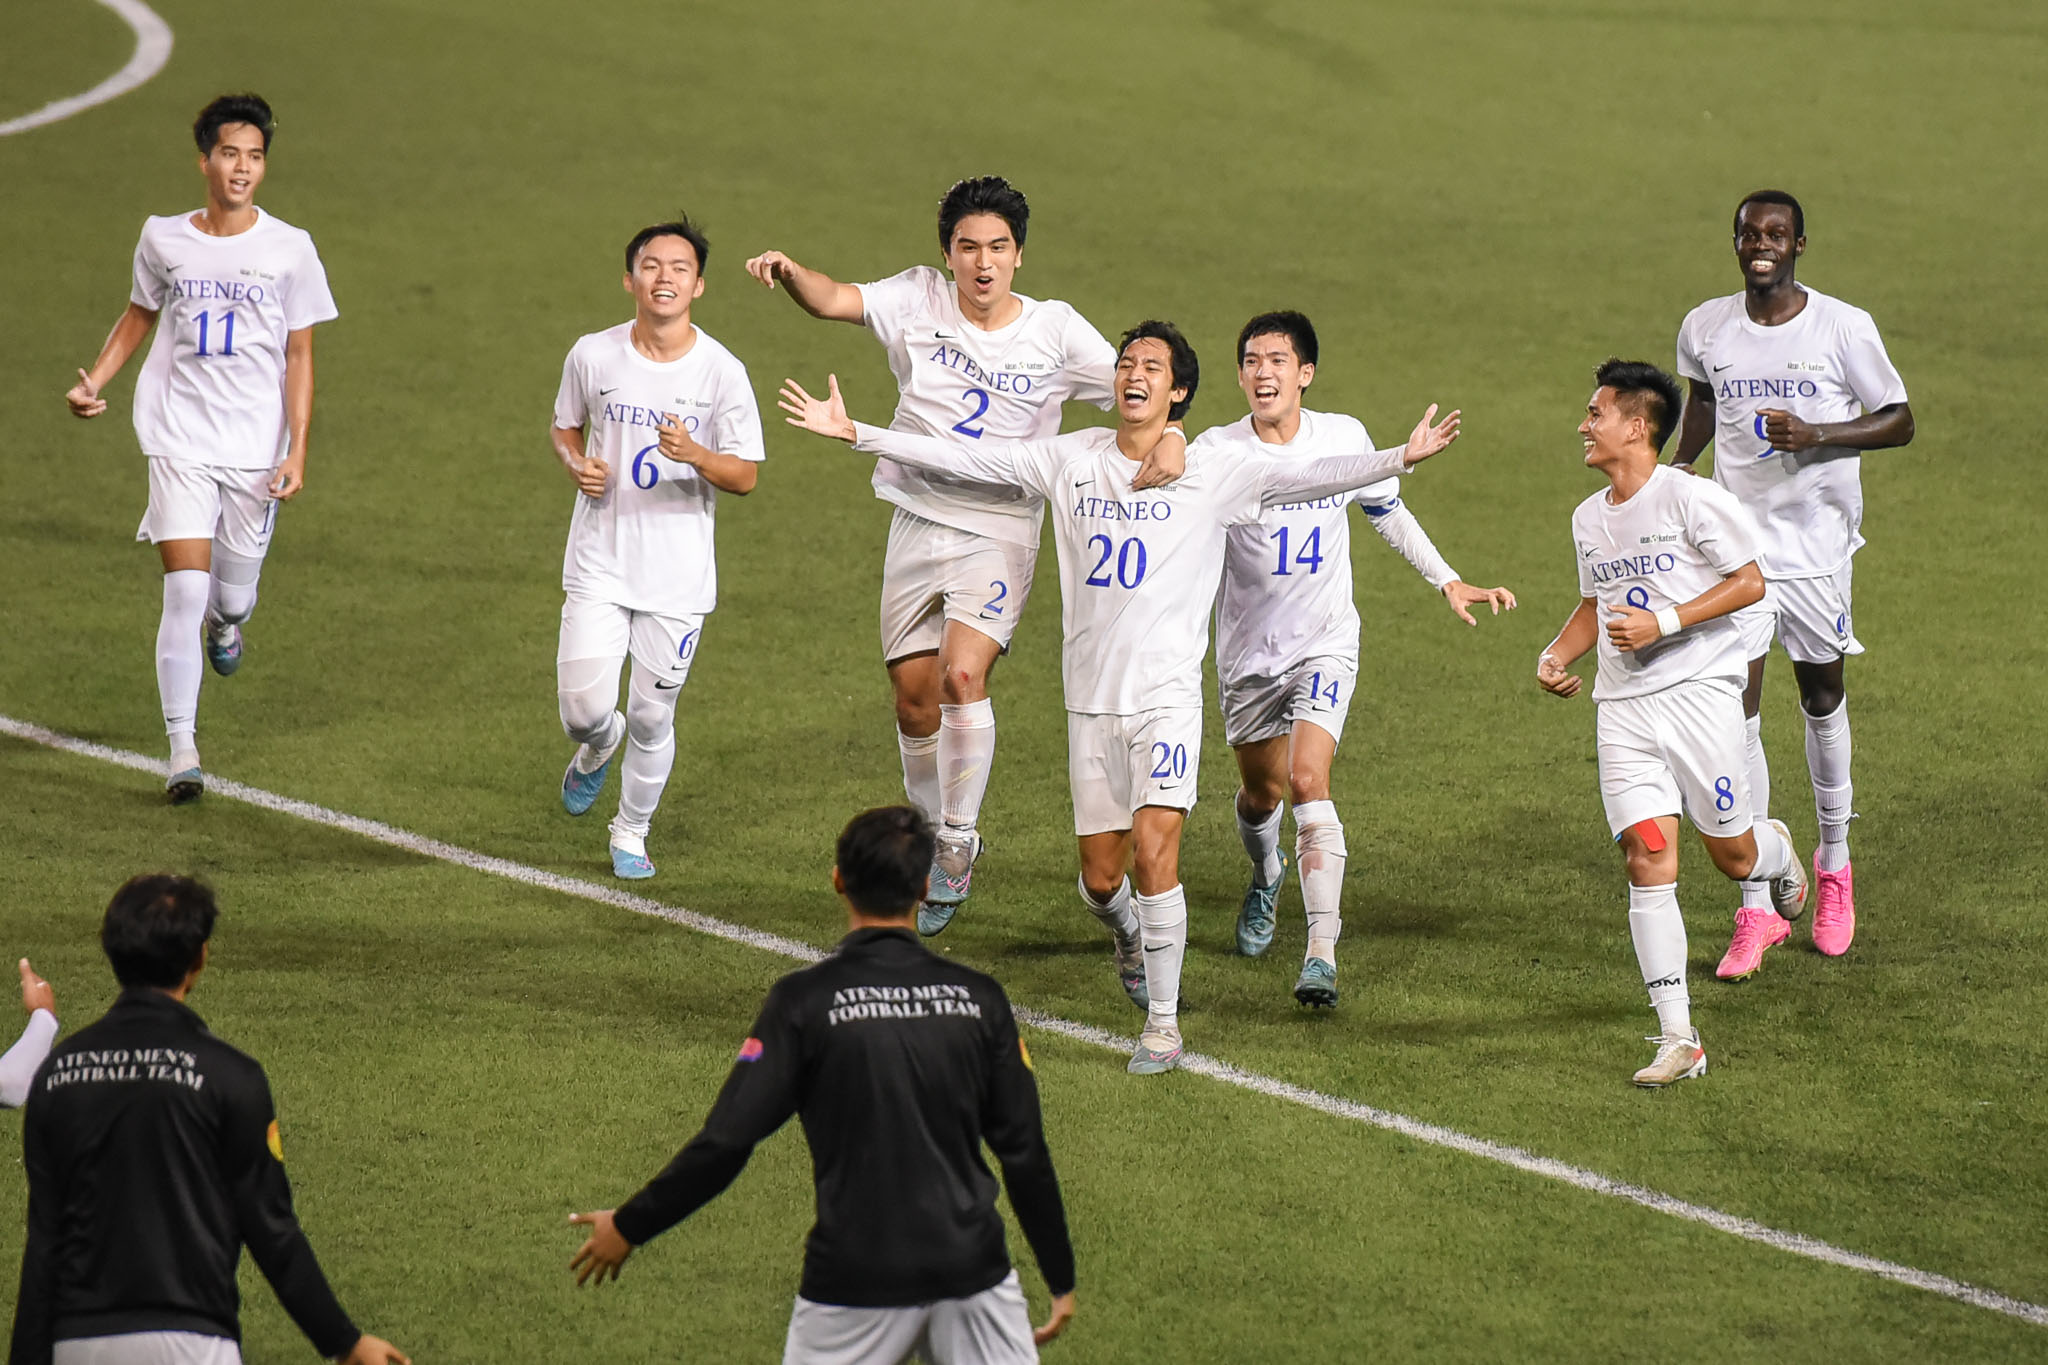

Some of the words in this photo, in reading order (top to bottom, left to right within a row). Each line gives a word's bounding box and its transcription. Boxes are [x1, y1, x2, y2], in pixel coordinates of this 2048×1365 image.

[173, 279, 264, 303] ATENEO
[192, 310, 239, 357] 11
[929, 344, 1031, 395] ATENEO
[1720, 379, 1817, 399] ATENEO
[952, 388, 990, 440] 2
[632, 444, 660, 490] 6
[1074, 496, 1171, 521] ATENEO
[1085, 533, 1147, 590] 20
[1270, 526, 1324, 576] 14
[1591, 553, 1675, 583] ATENEO
[983, 580, 1007, 615] 2
[679, 627, 699, 660] 6
[1307, 671, 1339, 709] 14
[1150, 741, 1187, 779] 20
[1714, 776, 1735, 811] 8
[828, 1000, 929, 1027] FOOTBALL
[931, 998, 982, 1020] TEAM
[833, 986, 910, 1006] ATENEO
[911, 984, 971, 1001] MEN'S
[55, 1050, 130, 1070] ATENEO
[133, 1048, 198, 1068] MEN'S
[46, 1065, 142, 1092] FOOTBALL
[145, 1064, 205, 1092] TEAM
